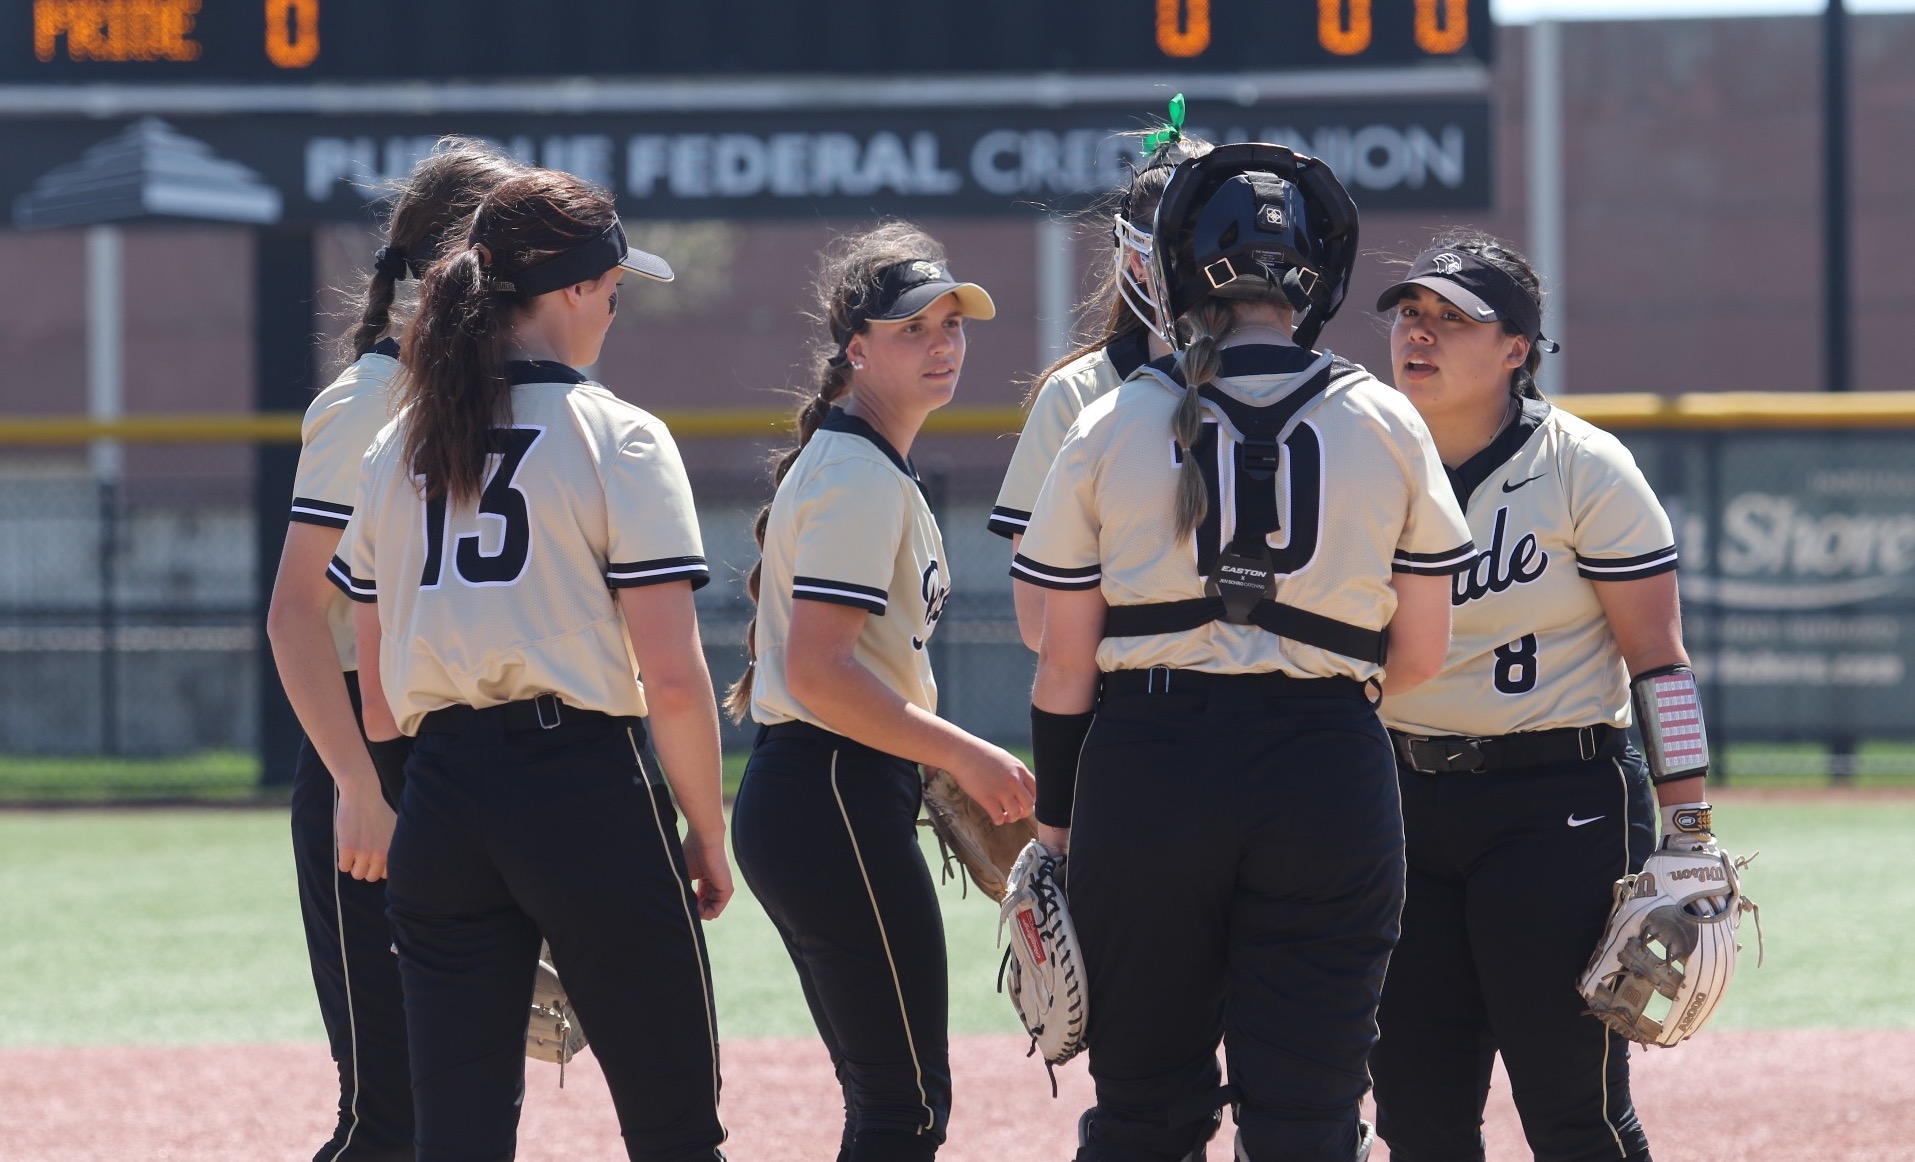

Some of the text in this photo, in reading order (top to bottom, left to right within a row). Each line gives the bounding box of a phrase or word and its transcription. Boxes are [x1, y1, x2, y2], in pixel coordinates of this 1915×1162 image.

[265, 0, 320, 68] 0
[303, 134, 616, 201] PUUE
[626, 131, 963, 198] FEDERAL
[969, 126, 1214, 197] CRED
[408, 423, 548, 592] 13
[1170, 417, 1326, 582] 10
[1221, 565, 1267, 578] EASTON
[1492, 631, 1539, 697] 8
[1670, 866, 1725, 882] Wilson
[1679, 992, 1707, 1033] A2000
